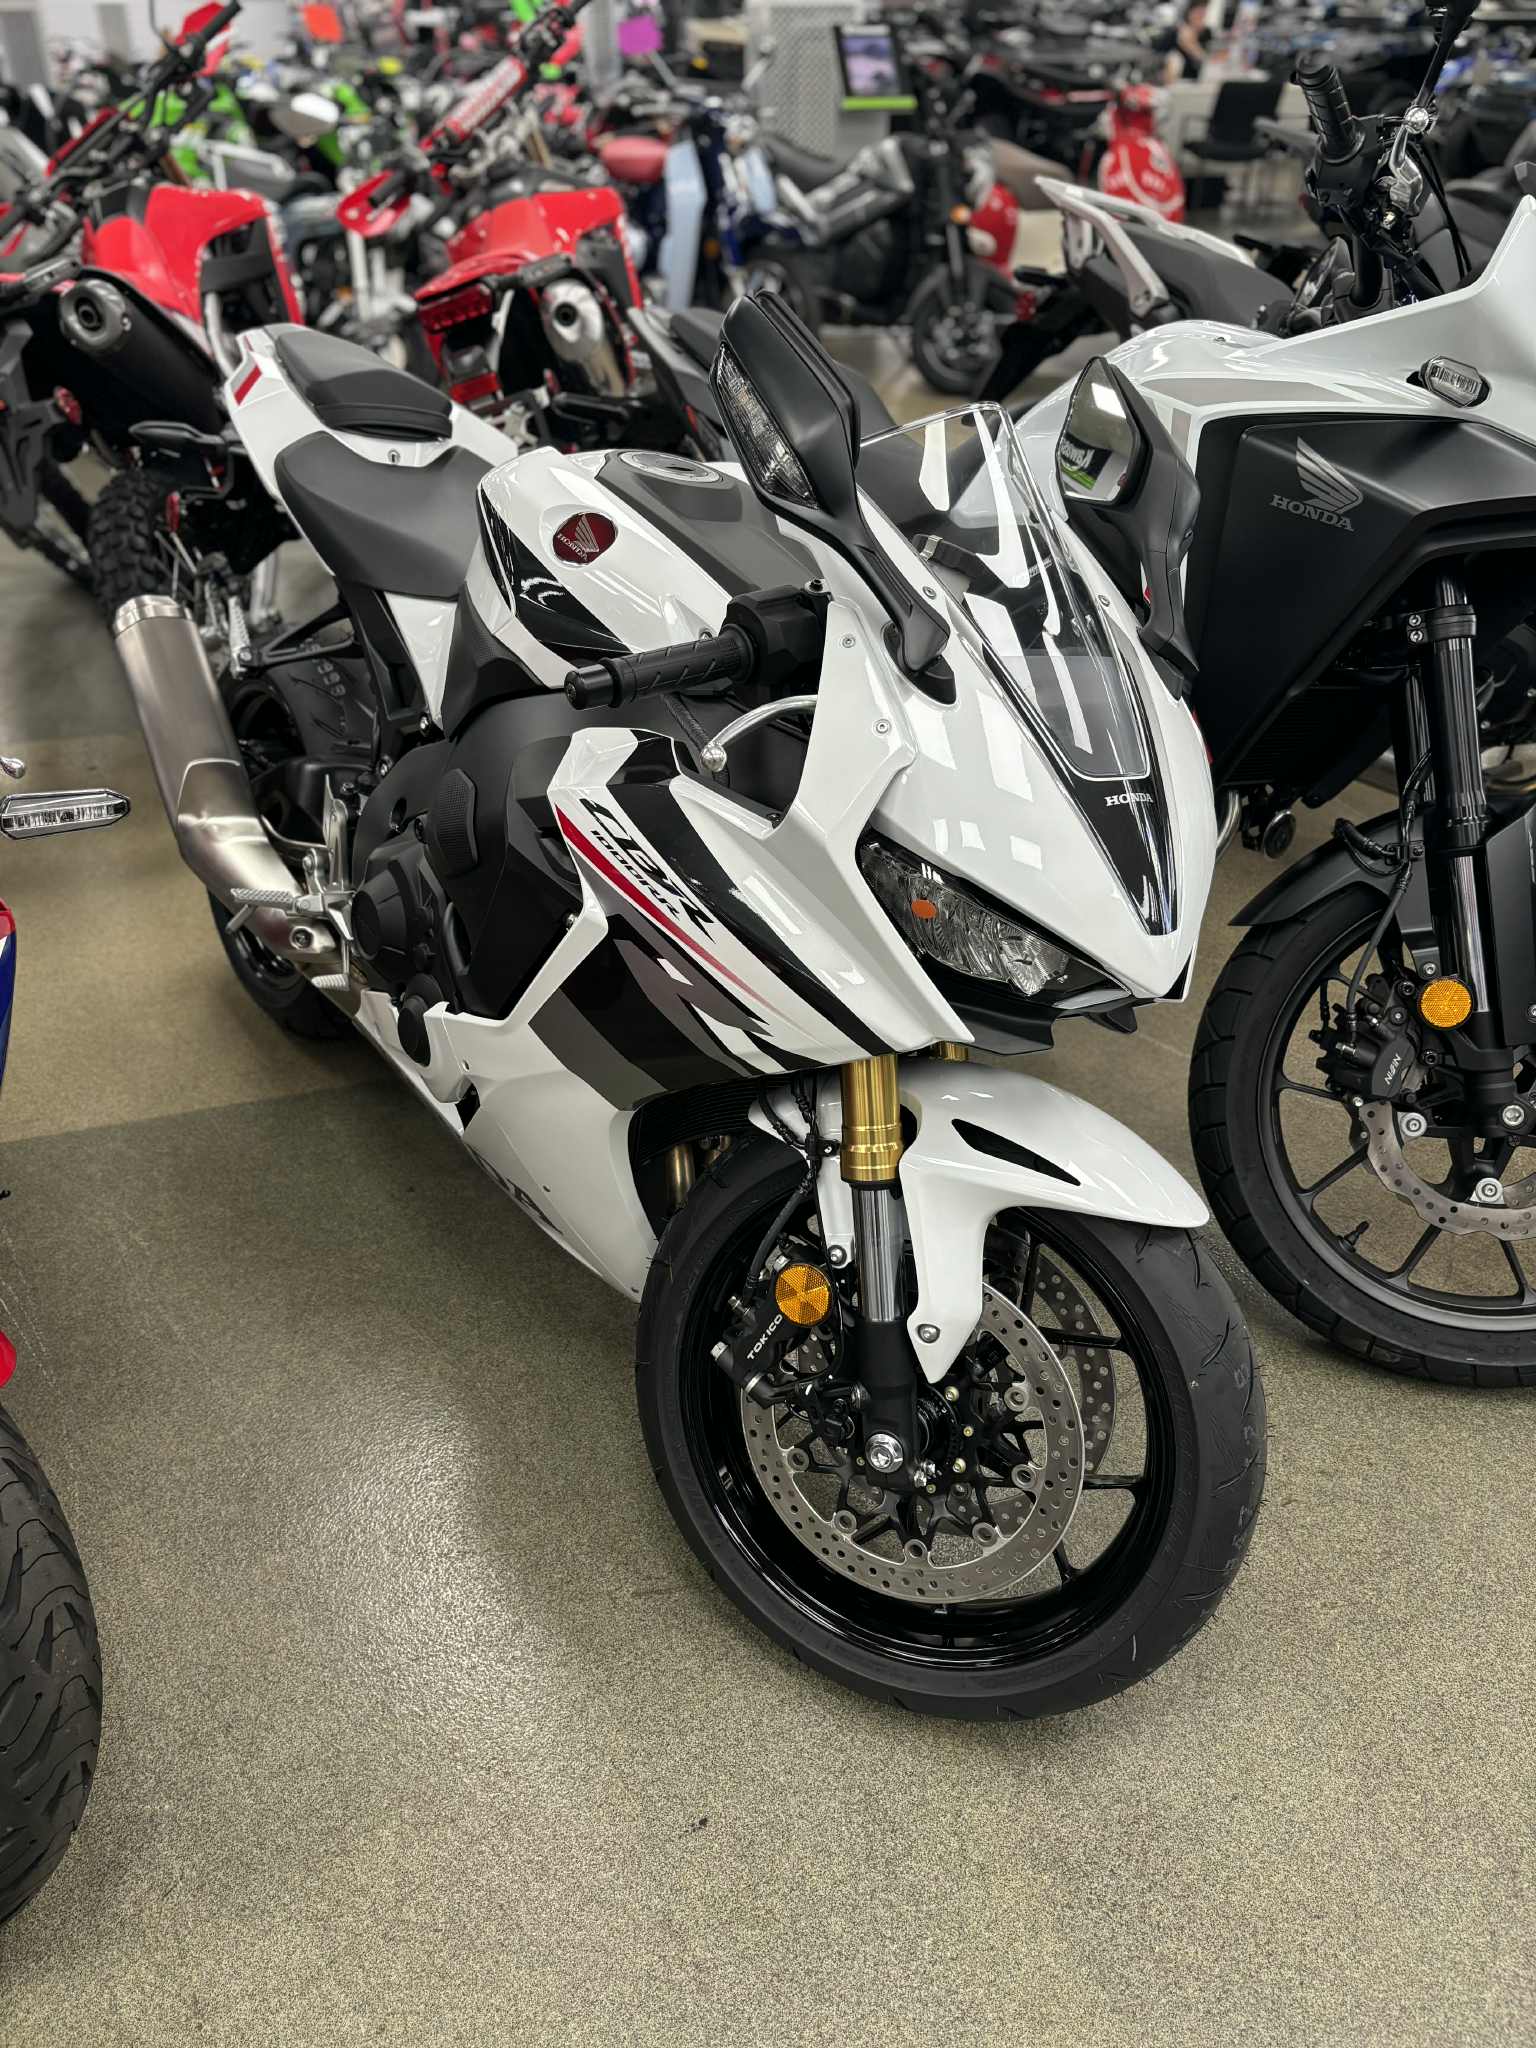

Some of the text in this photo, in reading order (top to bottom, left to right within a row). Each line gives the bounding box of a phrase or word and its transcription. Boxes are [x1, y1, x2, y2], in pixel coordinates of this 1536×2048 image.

[1269, 494, 1355, 532] HONDA
[557, 532, 588, 561] HONDA
[1103, 792, 1154, 807] HONDA
[579, 798, 717, 944] CBR
[590, 829, 681, 922] 1000RR
[746, 1313, 784, 1360] TOKICO
